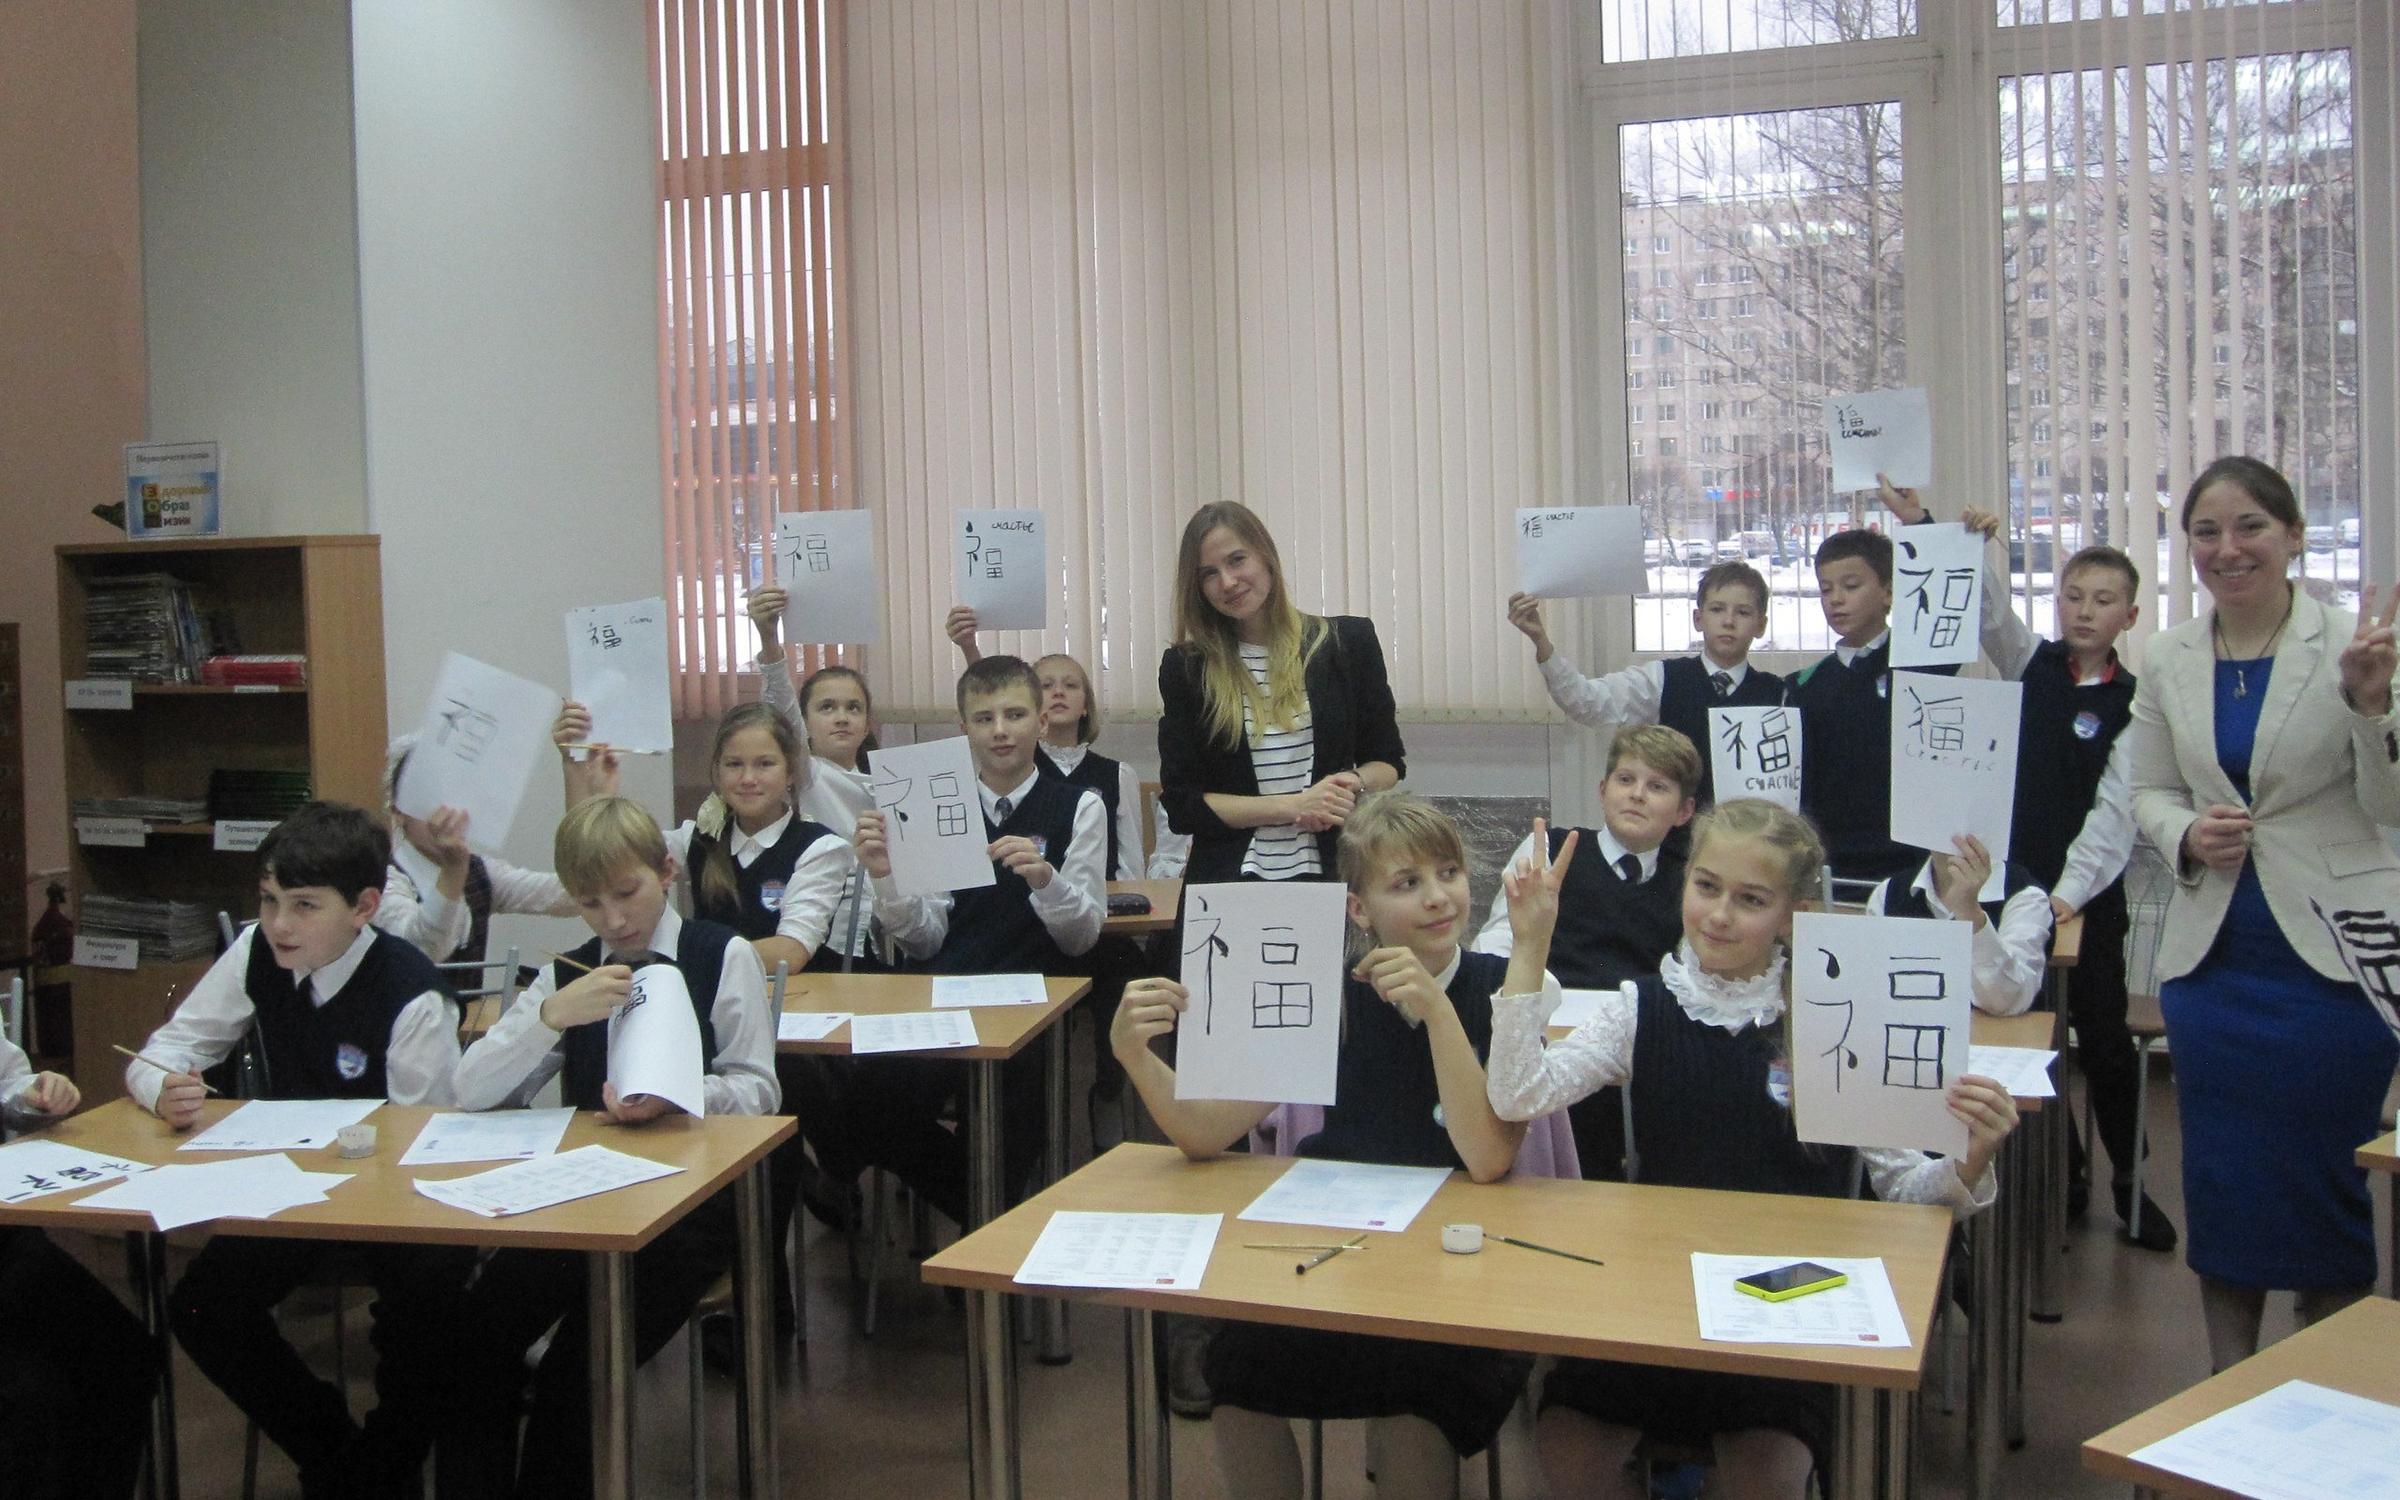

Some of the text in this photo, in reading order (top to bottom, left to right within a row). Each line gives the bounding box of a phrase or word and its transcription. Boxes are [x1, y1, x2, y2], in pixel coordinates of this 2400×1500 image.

[784, 524, 831, 580] 福
[965, 520, 1004, 579] 福
[1898, 541, 1975, 650] 福
[1721, 705, 1792, 773] 福
[875, 765, 968, 842] 福
[1184, 896, 1313, 1036] 福
[1806, 947, 1950, 1093] 福
